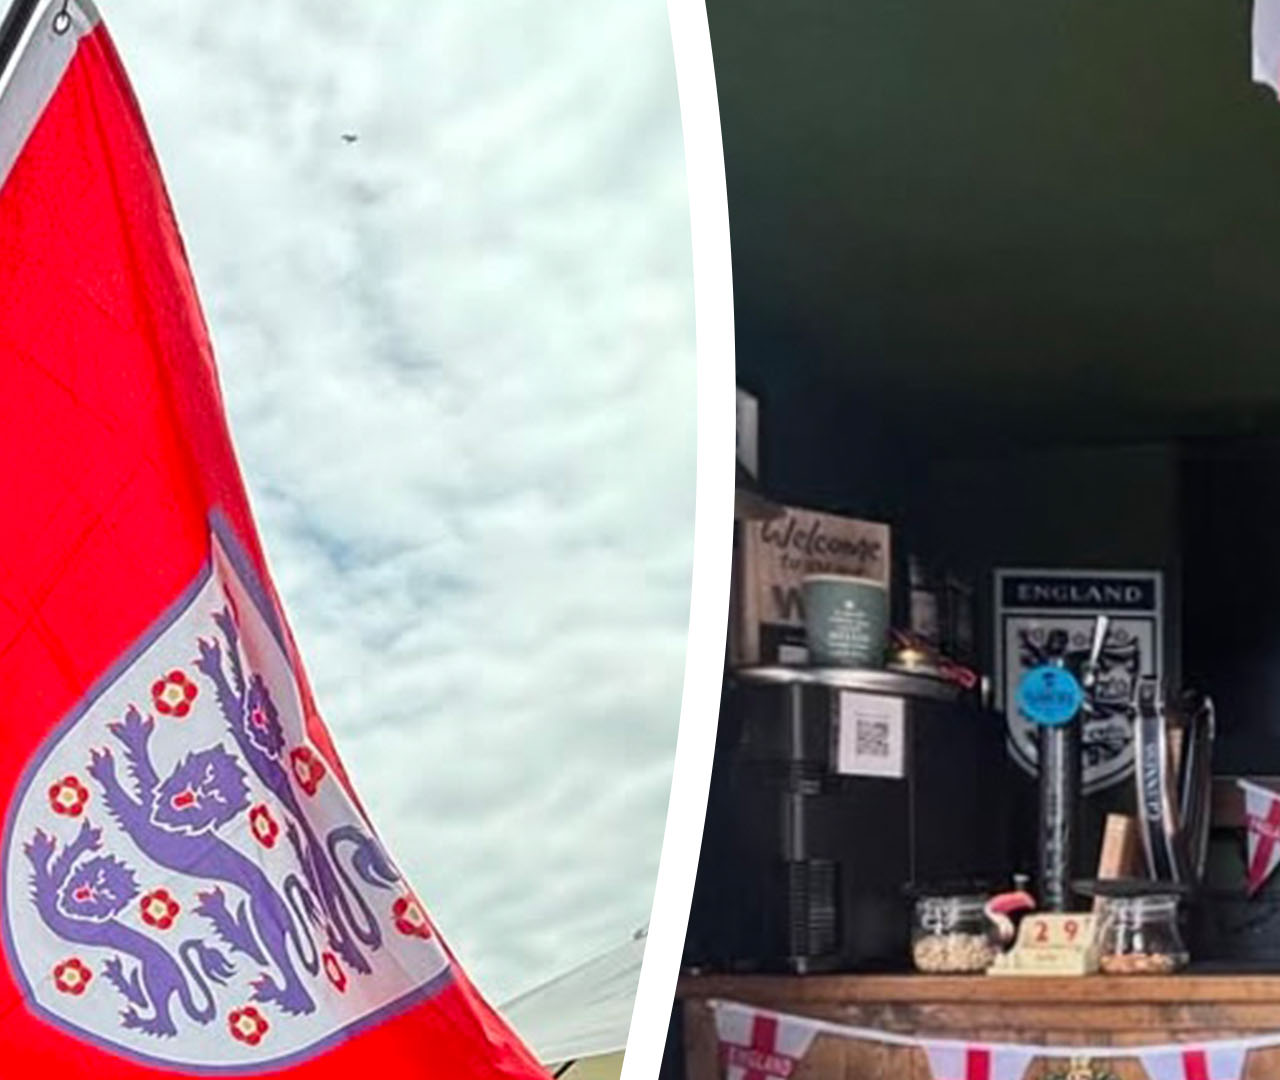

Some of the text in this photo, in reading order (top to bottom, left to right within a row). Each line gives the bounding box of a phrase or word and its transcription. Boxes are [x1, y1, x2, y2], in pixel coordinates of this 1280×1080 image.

[760, 516, 881, 562] Welcome
[1017, 585, 1142, 602] ENGLAND
[1034, 920, 1078, 942] 2 9
[728, 1047, 794, 1075] ENGLAND
